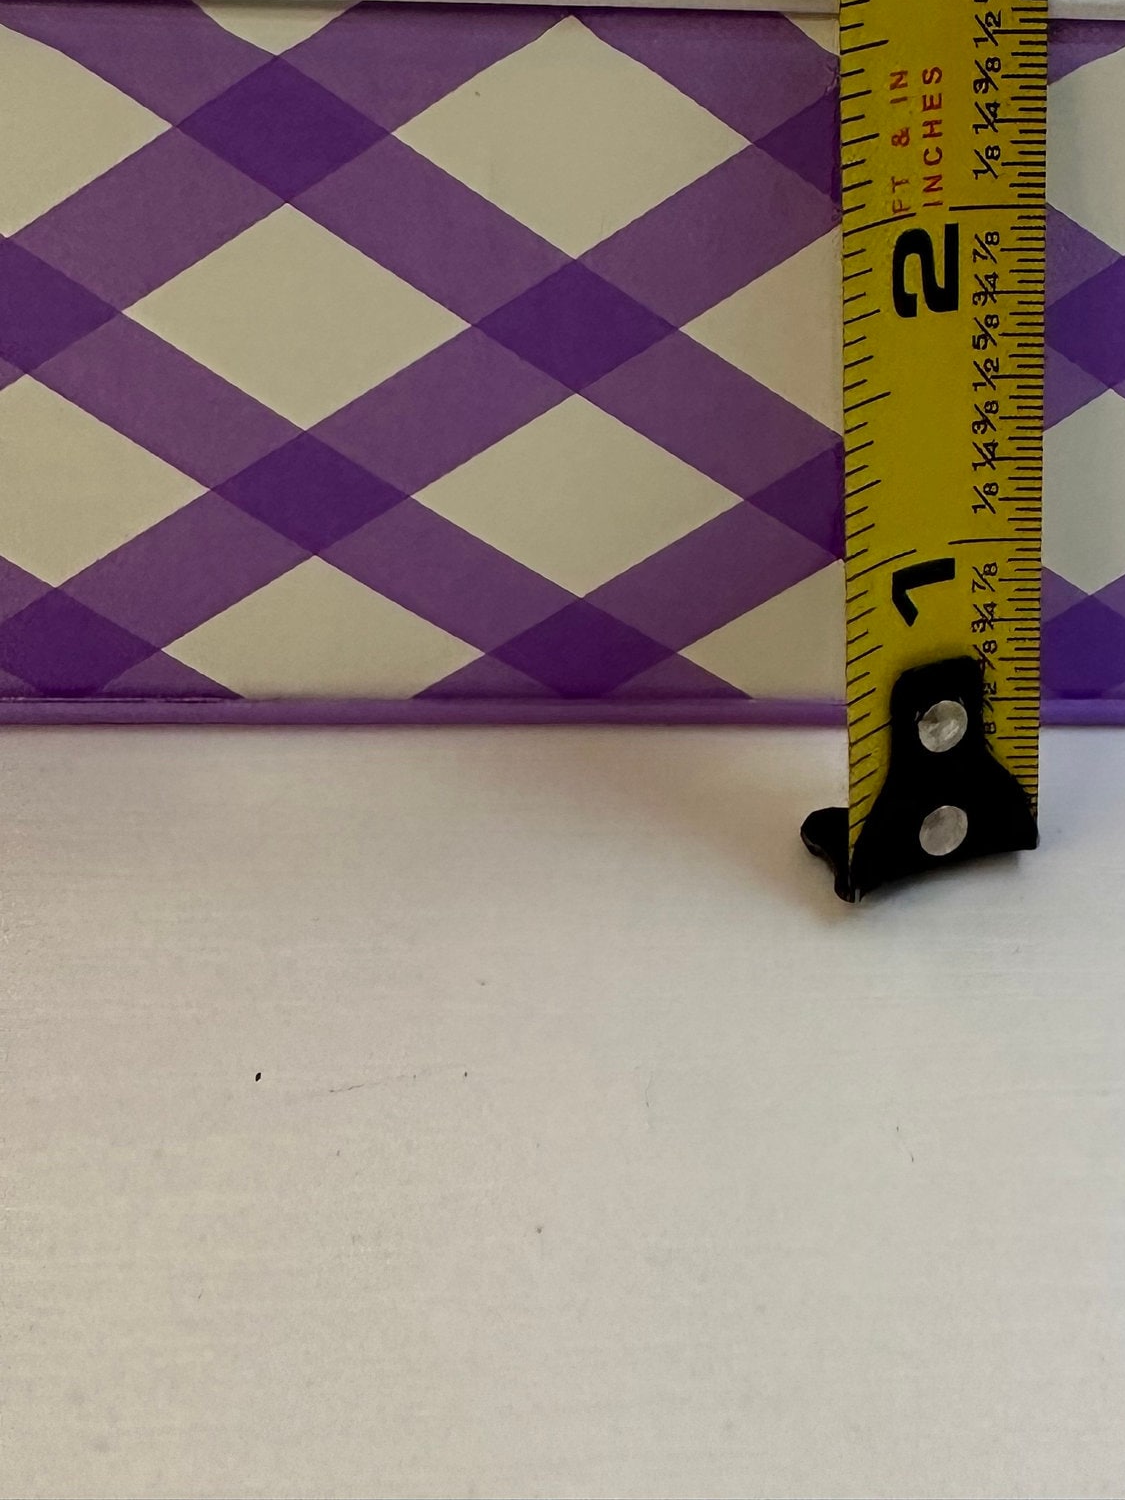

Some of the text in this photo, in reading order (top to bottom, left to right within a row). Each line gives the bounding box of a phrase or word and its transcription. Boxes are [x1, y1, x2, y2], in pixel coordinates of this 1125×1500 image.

[973, 10, 1001, 48] 1/2
[973, 57, 1001, 94] 3/8
[973, 101, 1000, 134] 1/4
[890, 70, 910, 214] FT & IN
[922, 67, 943, 207] INCHES
[972, 145, 1000, 180] 1/8
[972, 231, 1000, 264] 7/8
[892, 223, 959, 318] 2
[972, 272, 999, 306] 3/4
[972, 314, 999, 350] 5/8
[972, 357, 999, 391] 1/2
[972, 400, 999, 434] 3/8
[972, 440, 998, 471] 1/4
[972, 482, 999, 514] 1/8
[891, 558, 955, 627] 1
[972, 562, 997, 593] 7/8
[971, 602, 996, 633] 3/4
